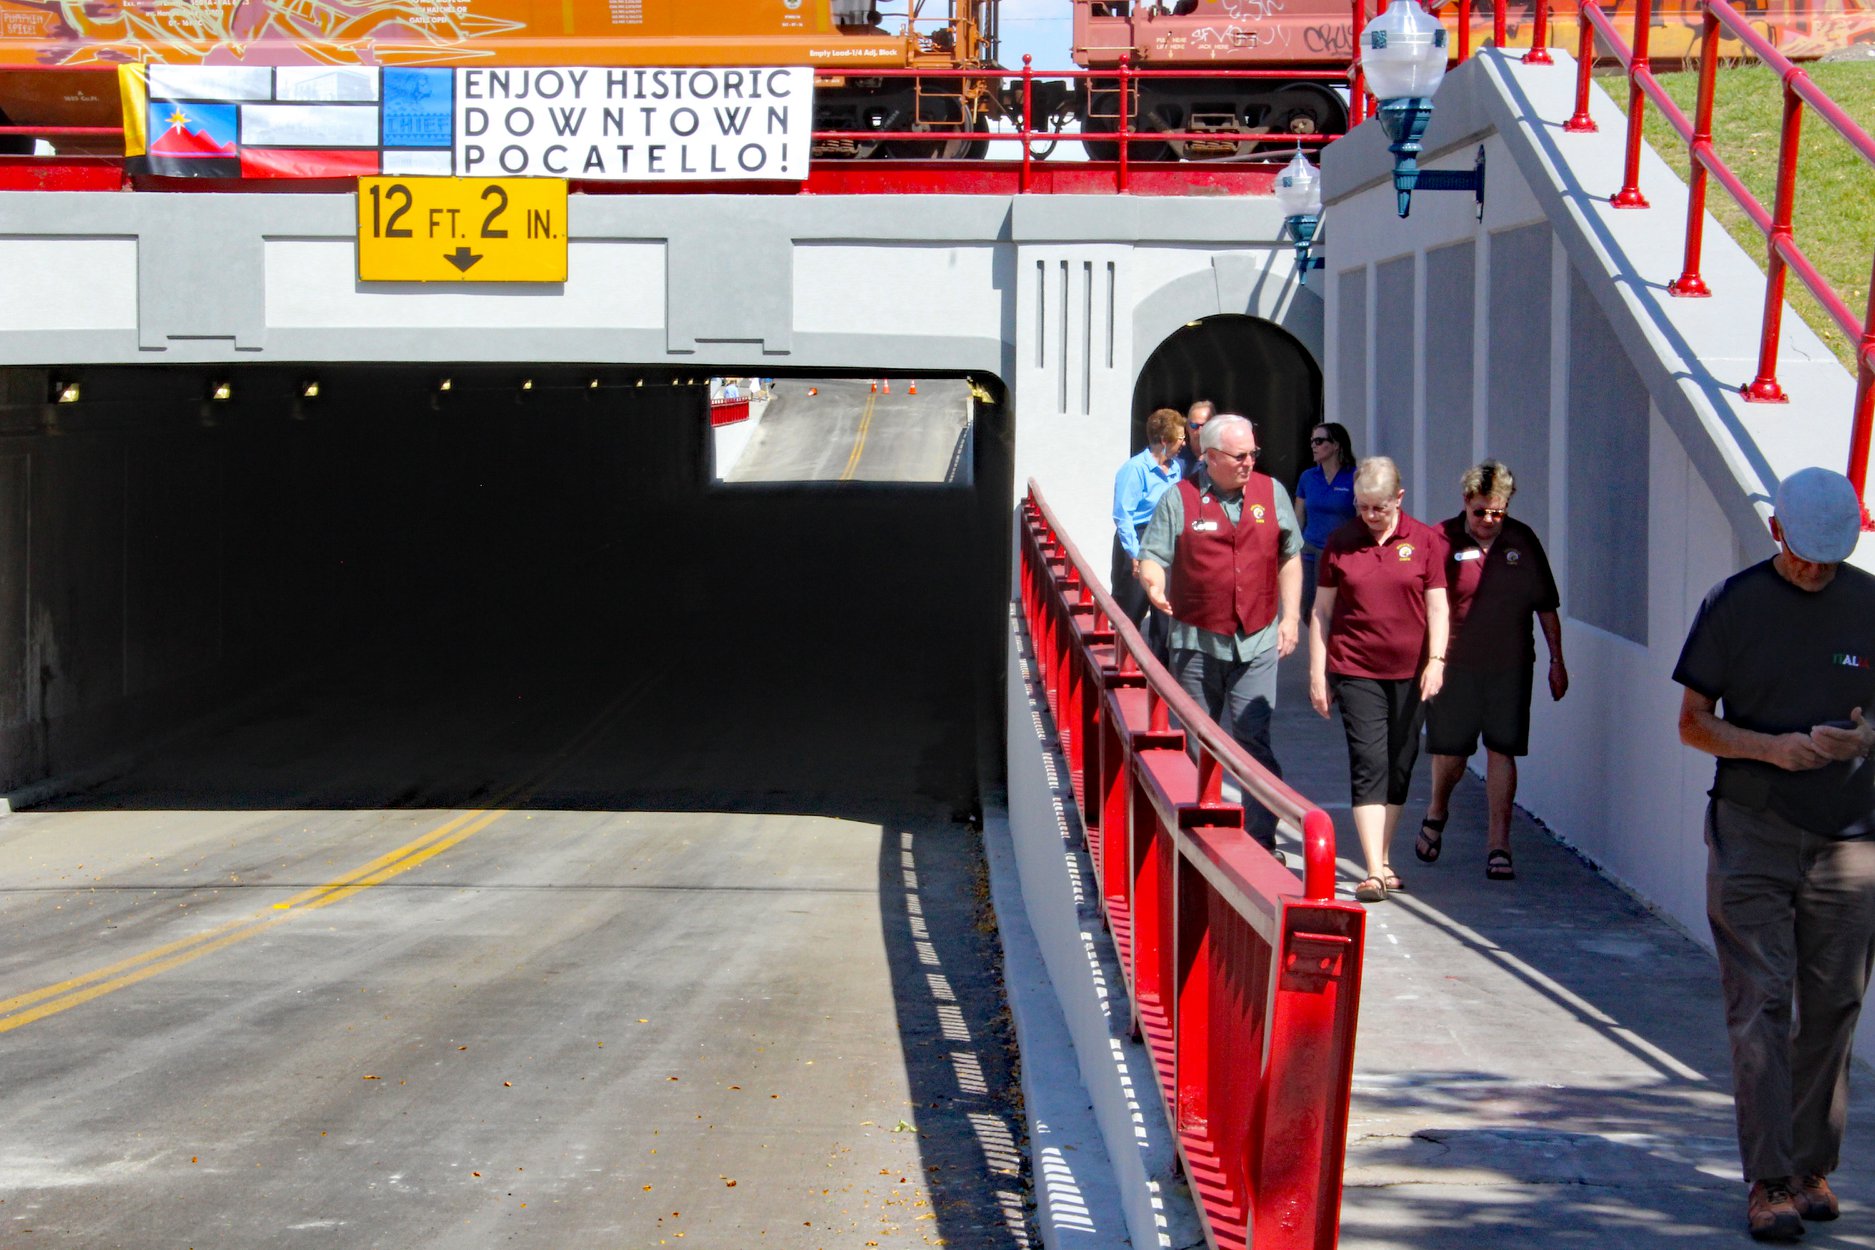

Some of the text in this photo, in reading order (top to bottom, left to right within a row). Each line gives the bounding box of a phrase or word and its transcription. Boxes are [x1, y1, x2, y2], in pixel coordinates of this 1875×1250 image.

[810, 49, 831, 57] Empty
[864, 49, 877, 57] Adj.
[879, 48, 897, 56] Block
[465, 69, 792, 99] ENJOY HISTORIC
[465, 106, 788, 137] DOWNTOWN
[465, 143, 788, 174] POCATELLO!
[369, 184, 557, 239] 12 FT. 2 IN.
